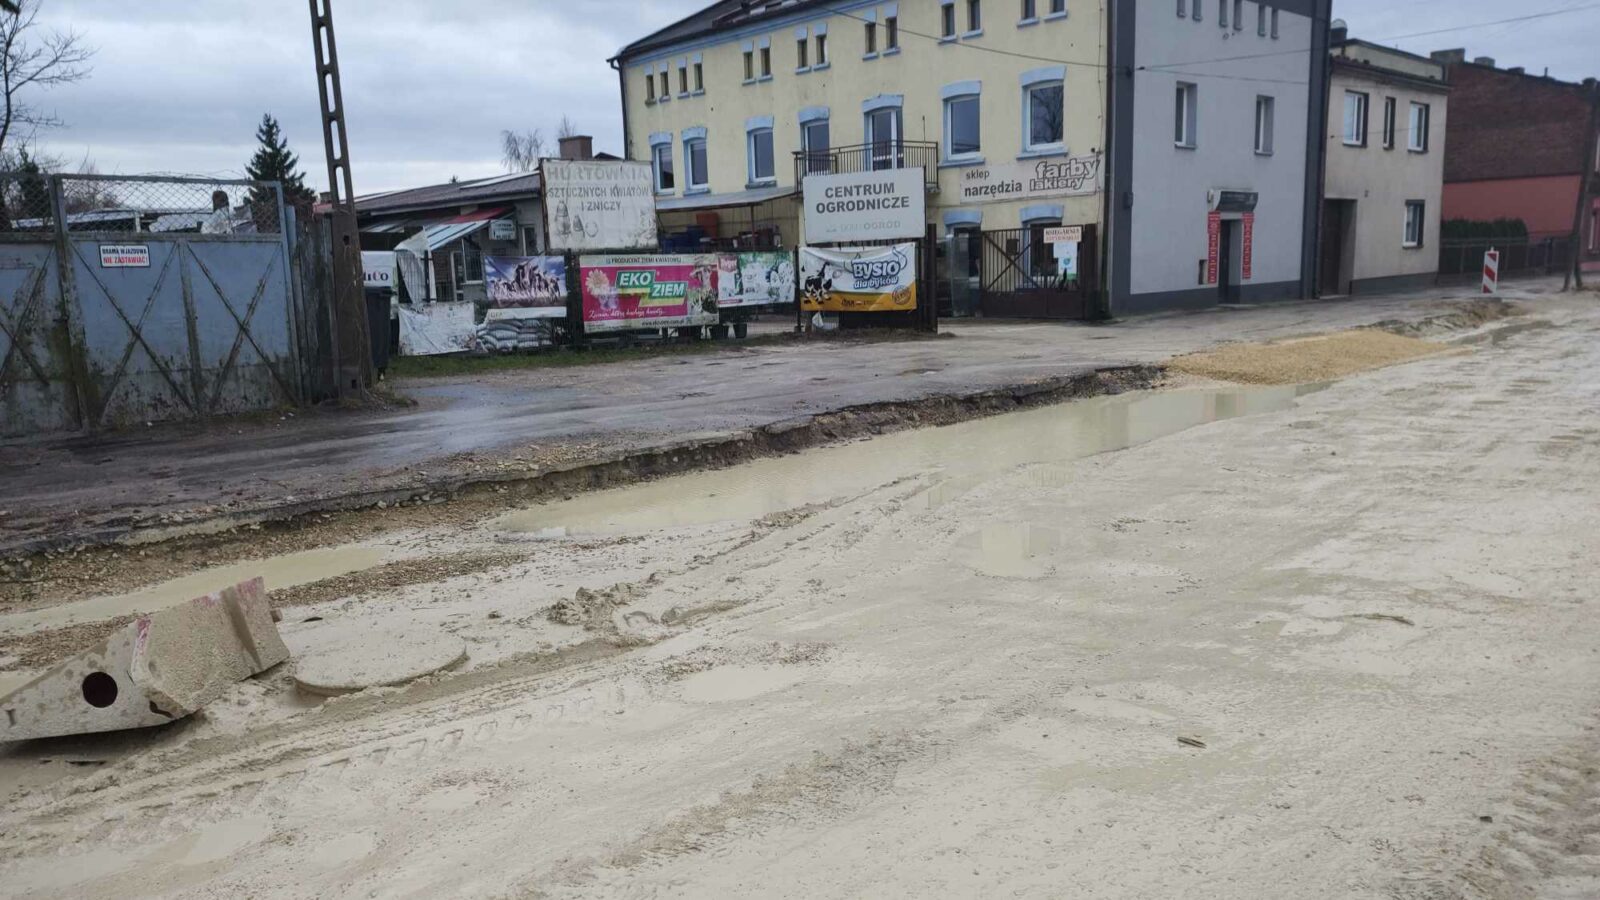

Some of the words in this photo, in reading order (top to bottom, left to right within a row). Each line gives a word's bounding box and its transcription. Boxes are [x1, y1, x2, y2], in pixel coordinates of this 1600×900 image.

[965, 169, 990, 180] sklep
[1035, 158, 1099, 180] farby
[548, 186, 607, 198] SZTUCZNYCH
[825, 182, 896, 199] CENTRUM
[964, 180, 1023, 198] narzędzia
[816, 196, 910, 214] OGRODNICZE
[852, 260, 901, 280] BYSIO
[619, 272, 652, 286] EKO
[651, 283, 685, 297] ZIEM
